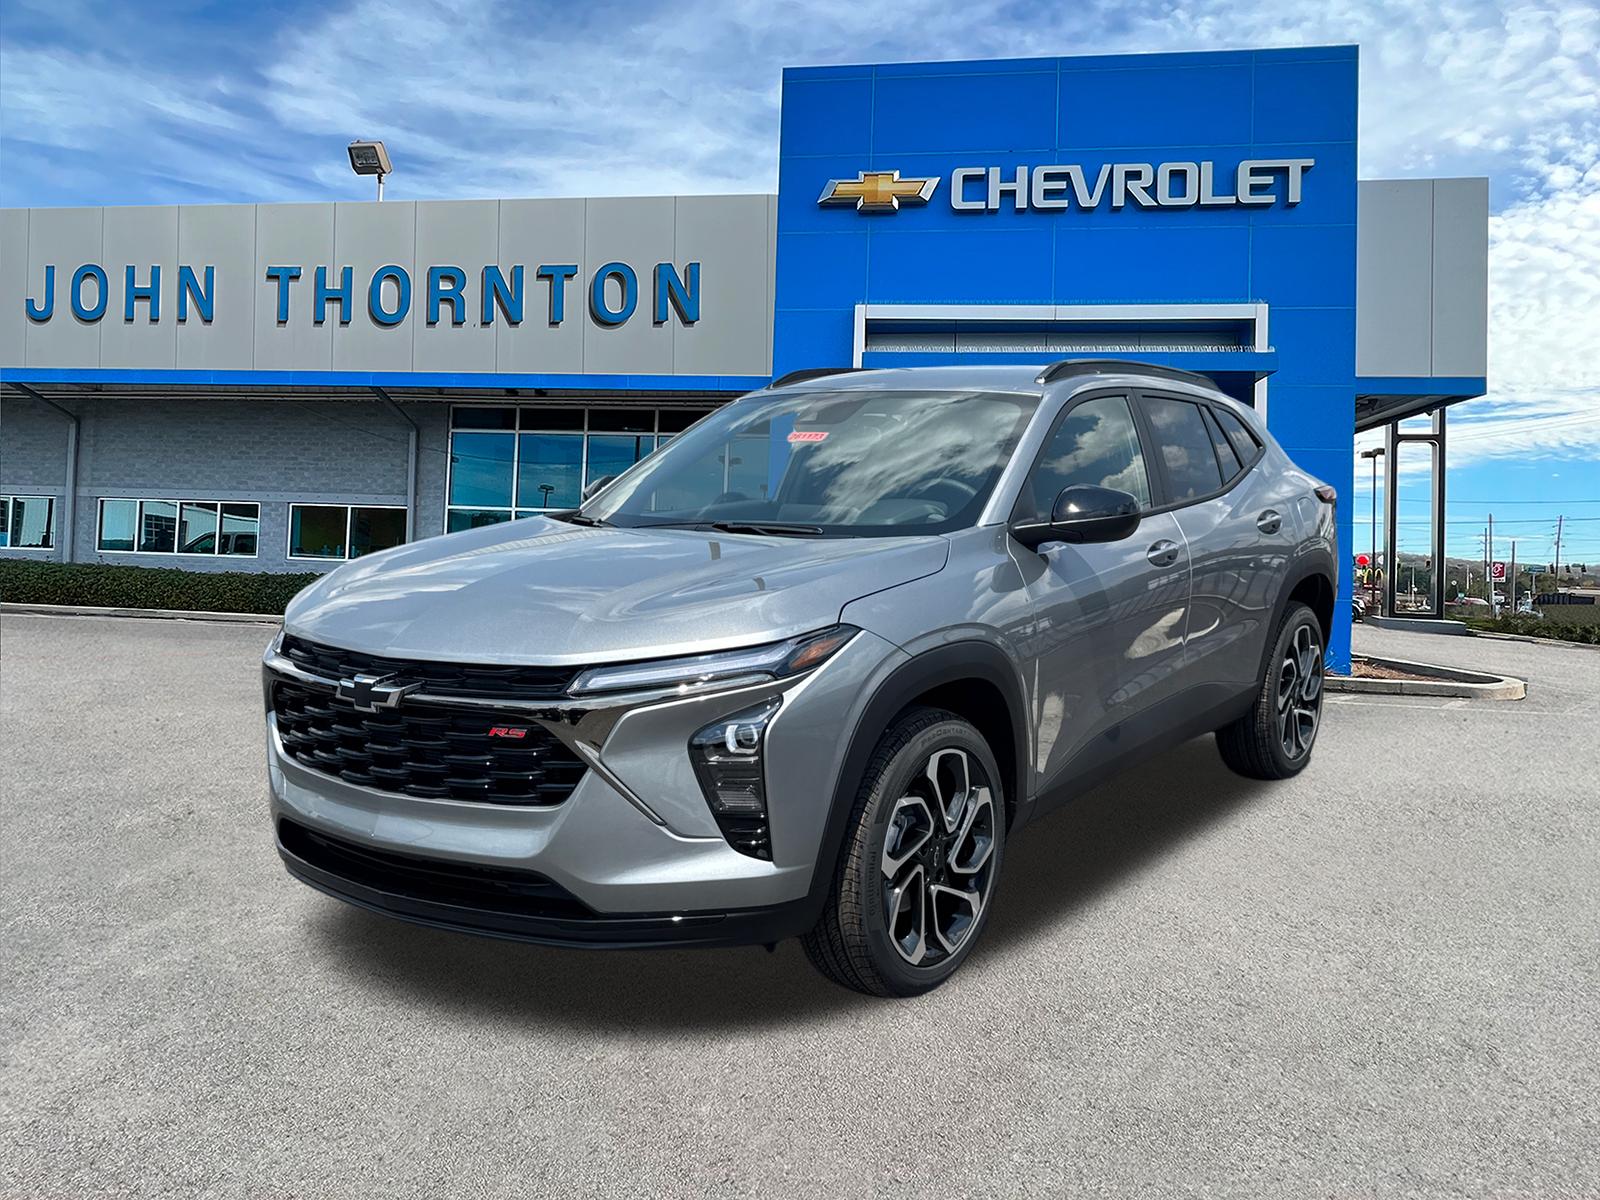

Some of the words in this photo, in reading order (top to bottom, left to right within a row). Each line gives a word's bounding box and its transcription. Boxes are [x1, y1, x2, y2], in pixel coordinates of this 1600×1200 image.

[951, 158, 1315, 210] CHEVROLET
[26, 264, 215, 323] JOHN
[266, 262, 702, 327] THORNTON
[488, 727, 527, 738] RS
